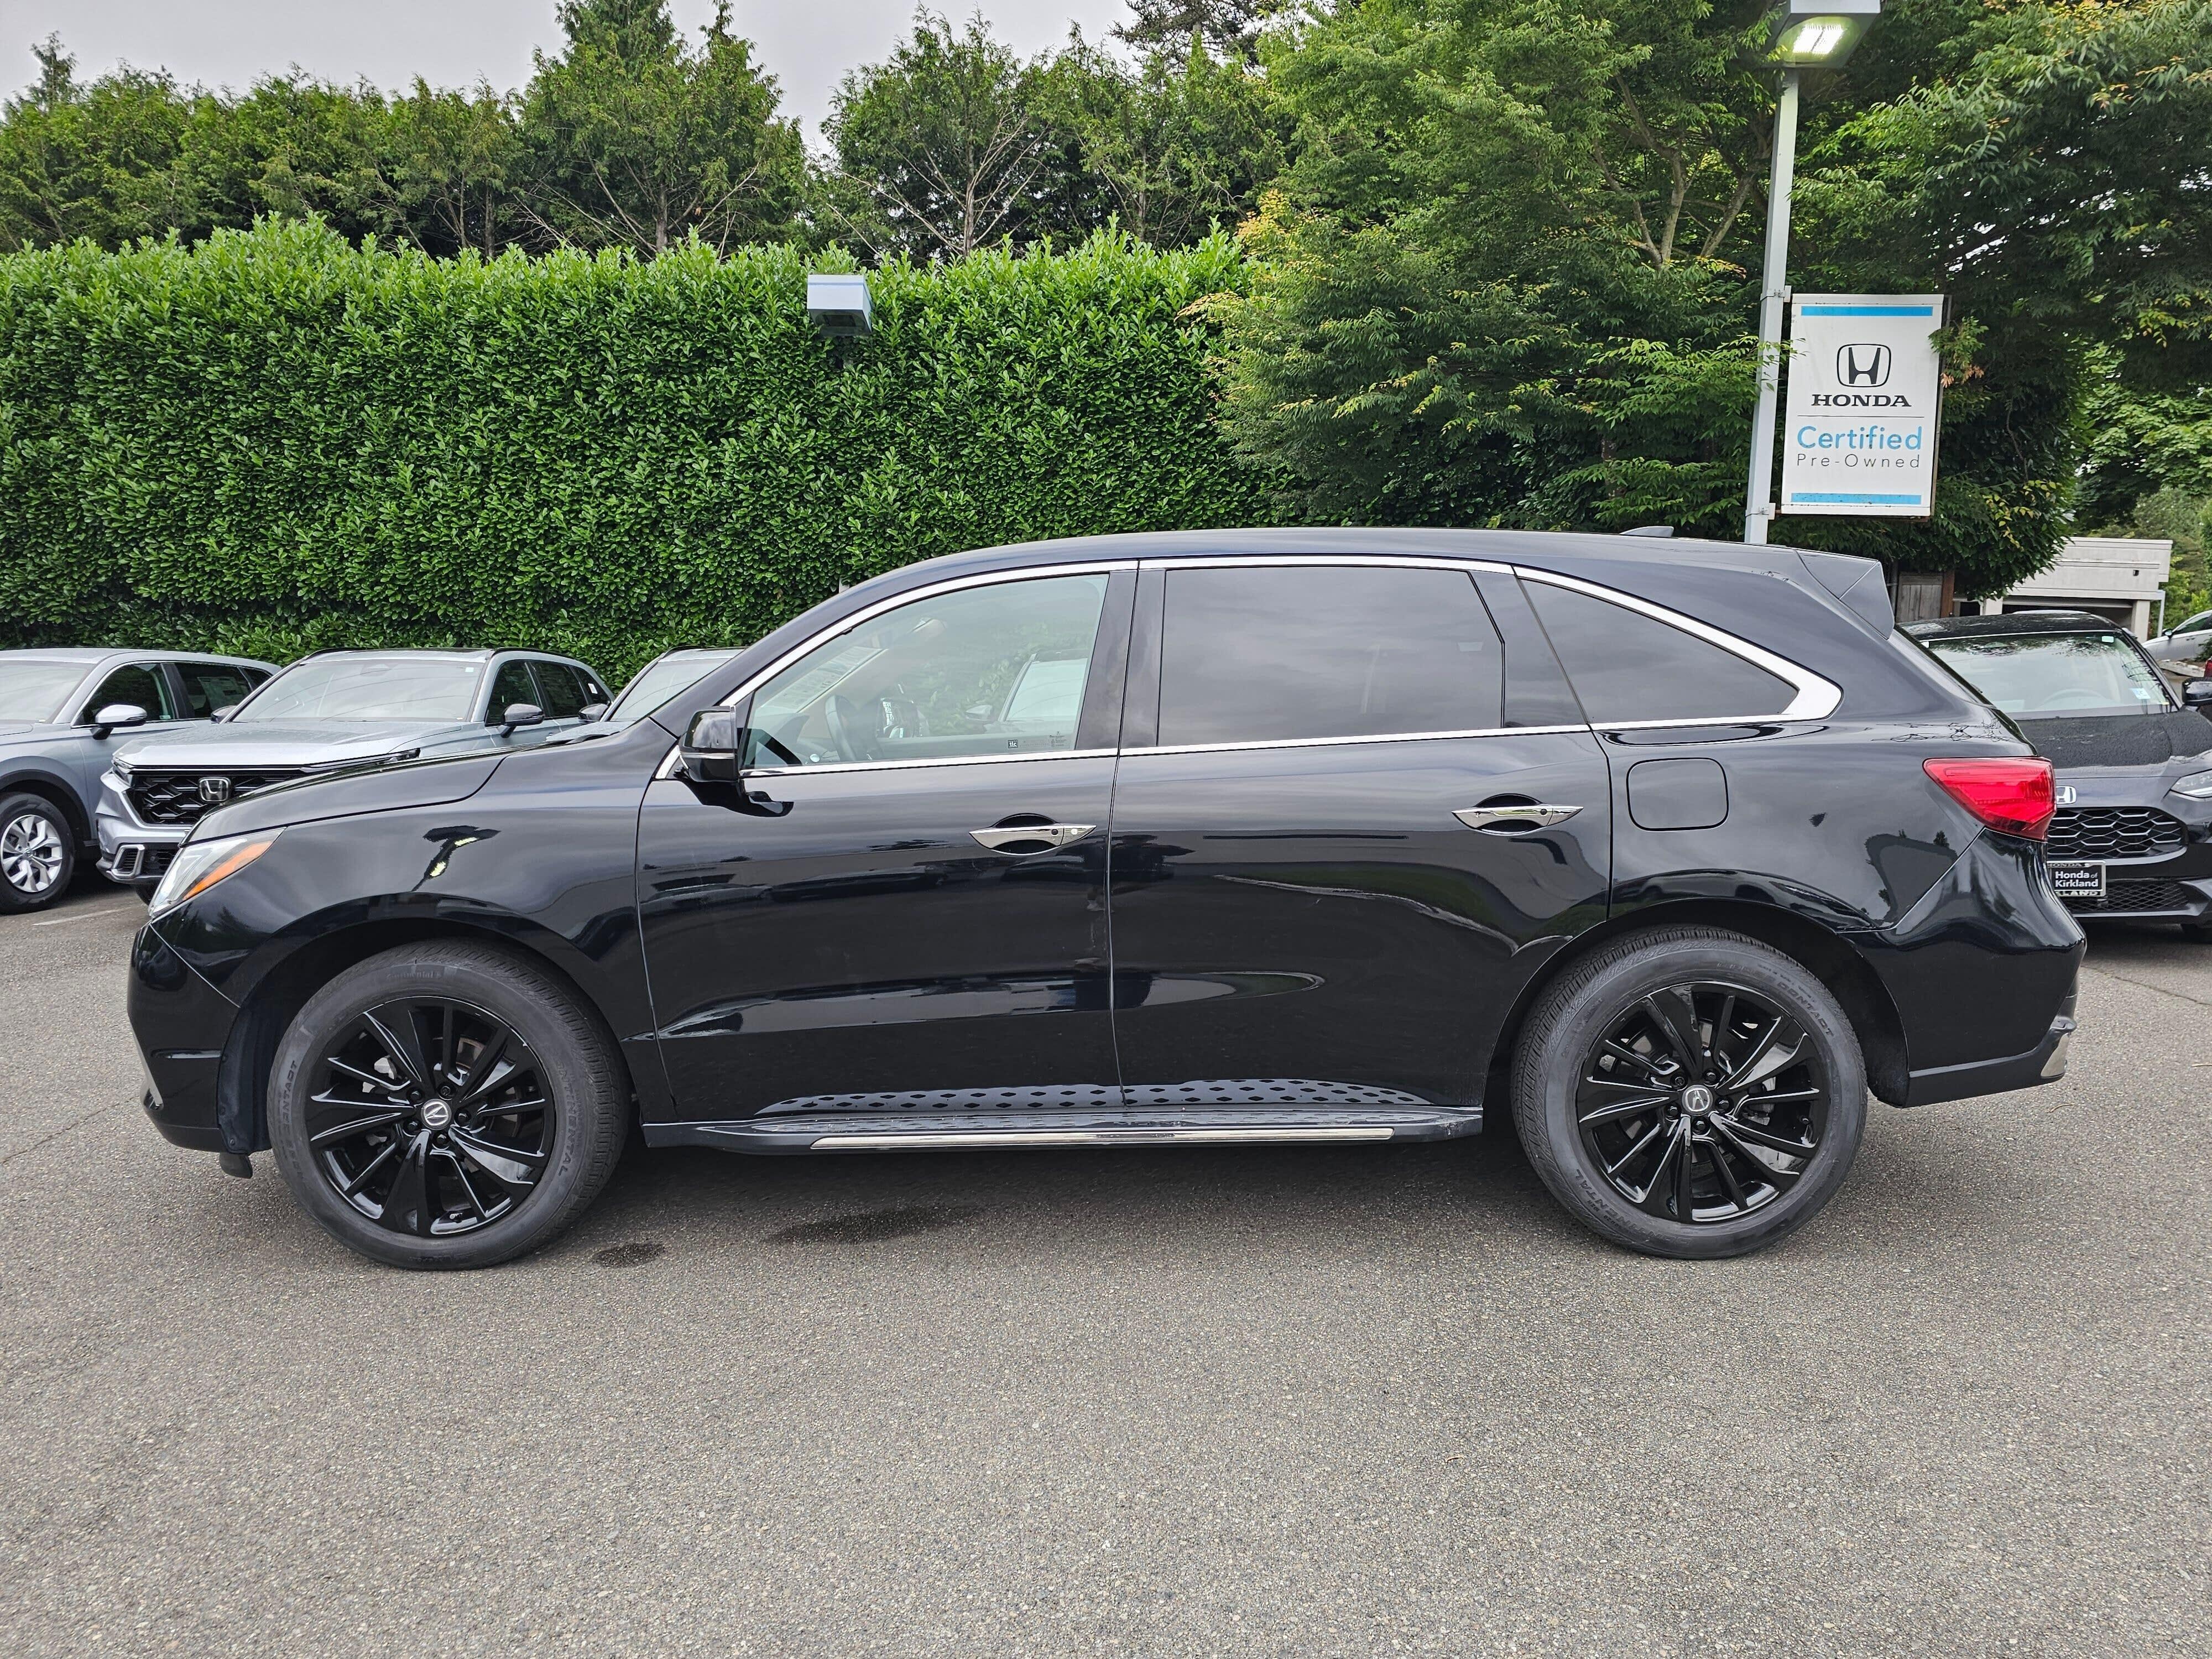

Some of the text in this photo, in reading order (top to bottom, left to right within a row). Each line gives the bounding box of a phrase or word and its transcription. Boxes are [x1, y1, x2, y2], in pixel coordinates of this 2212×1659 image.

[1811, 394, 1912, 408] HONDA
[1797, 425, 1922, 450] Certified
[1797, 453, 1919, 468] Pre-Owned
[2055, 870, 2090, 879] Honda
[2055, 879, 2099, 887] Kirkland
